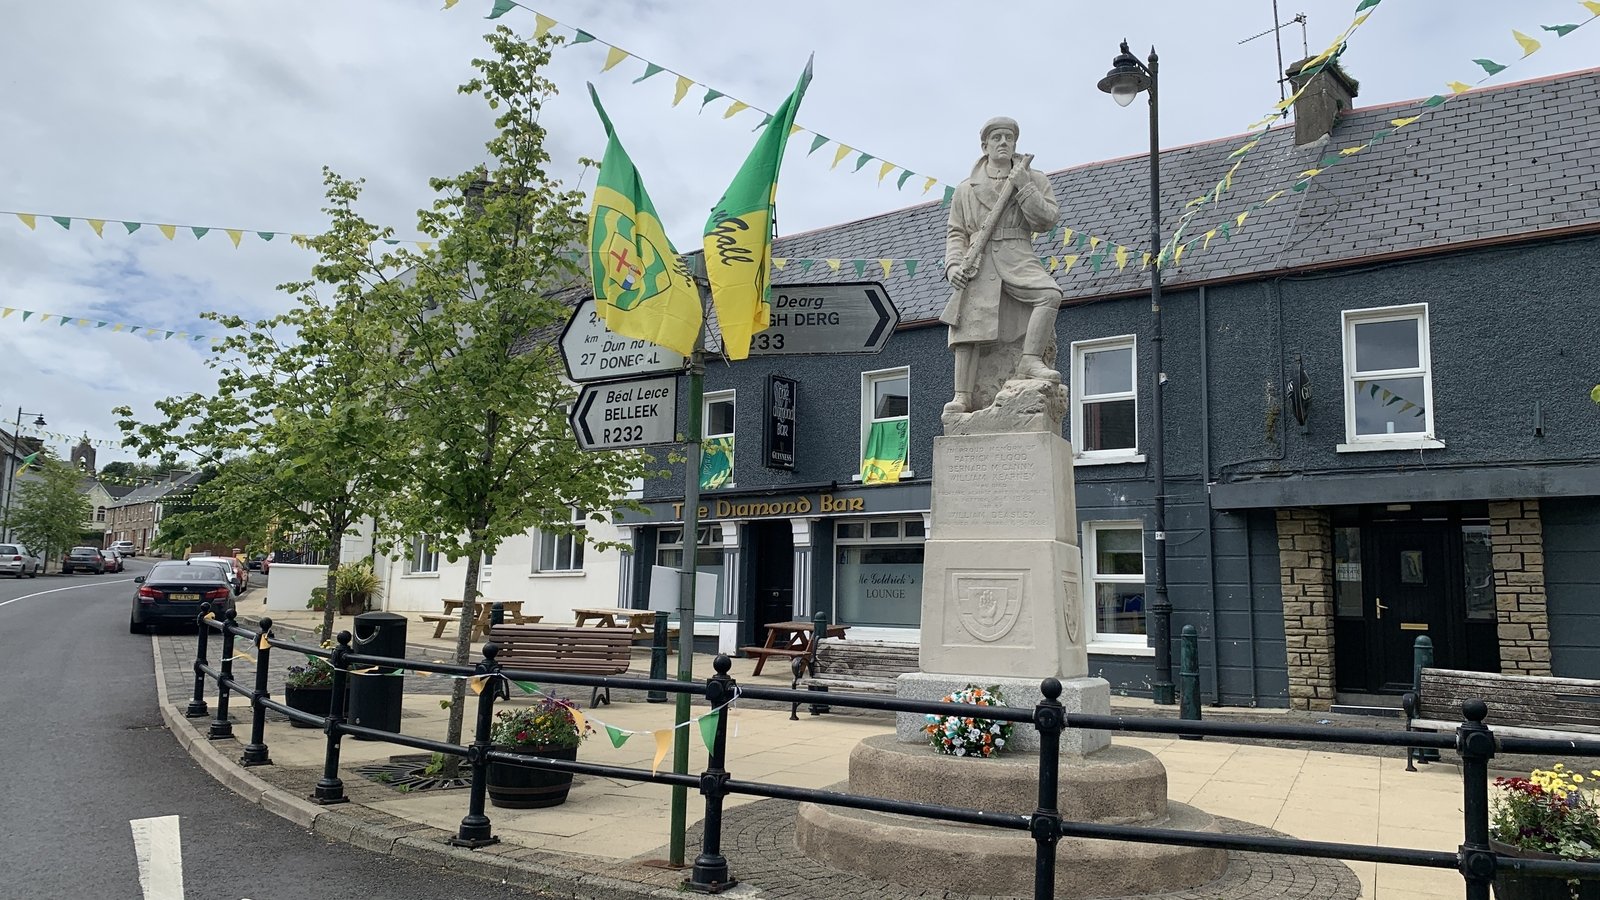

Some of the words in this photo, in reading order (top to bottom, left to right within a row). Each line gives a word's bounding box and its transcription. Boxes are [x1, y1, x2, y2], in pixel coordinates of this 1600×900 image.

[776, 294, 825, 310] Dearg
[588, 311, 602, 324] 2
[794, 311, 840, 326] DERG
[584, 334, 599, 344] km
[749, 333, 785, 350] 233
[580, 352, 597, 366] 27
[600, 352, 661, 370] DONEGL
[605, 388, 634, 404] Béal
[637, 386, 669, 401] Leice
[604, 403, 659, 422] BELLEEK
[603, 425, 644, 444] R232
[771, 450, 793, 462] GUINNESS
[954, 454, 990, 463] PATRICK
[994, 453, 1028, 462] FLOOD
[948, 464, 988, 474] BERNARD
[950, 473, 987, 482] WILLIAM
[992, 472, 1036, 481] KEARNEY
[672, 502, 710, 520] Te
[716, 497, 812, 518] Diamond
[951, 512, 986, 520] WILLIAM
[866, 588, 906, 599] LOUNGE
